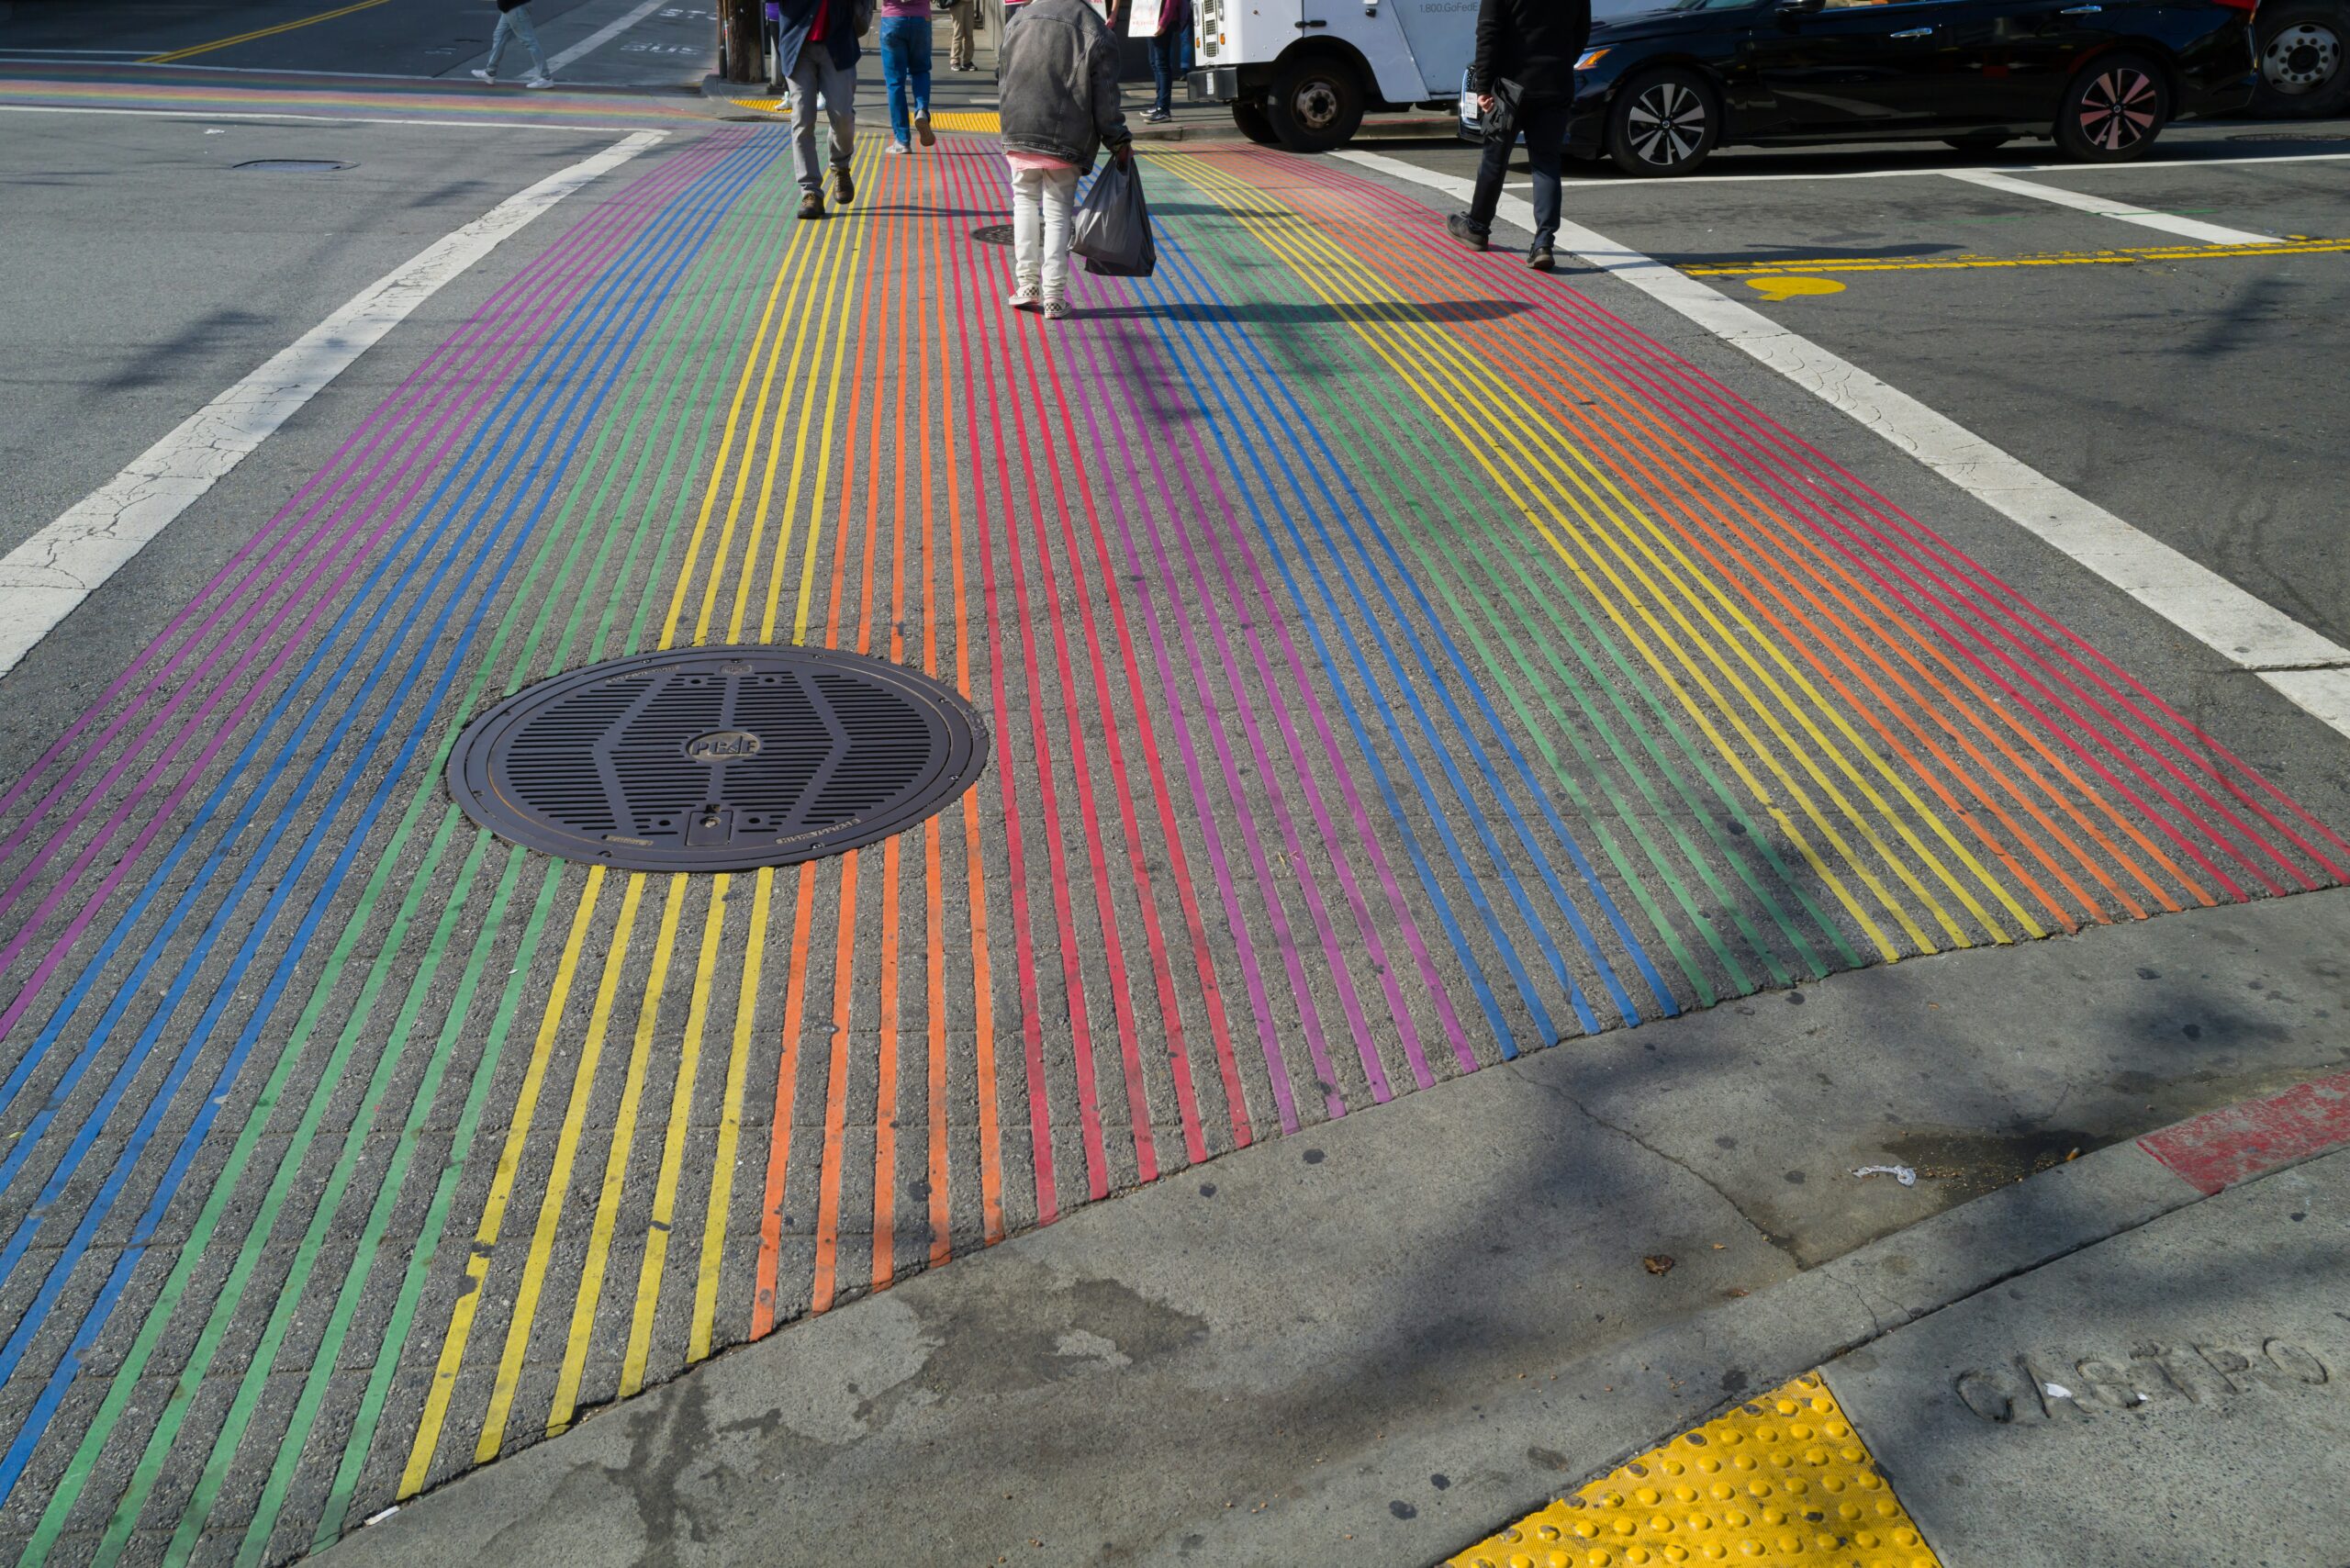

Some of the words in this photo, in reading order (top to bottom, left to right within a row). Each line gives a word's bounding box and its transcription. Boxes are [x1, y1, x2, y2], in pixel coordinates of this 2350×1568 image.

[1419, 2, 1479, 14] 1.800.GoFedE
[690, 735, 756, 755] PG&E
[1953, 1337, 2330, 1424] CASTRO
